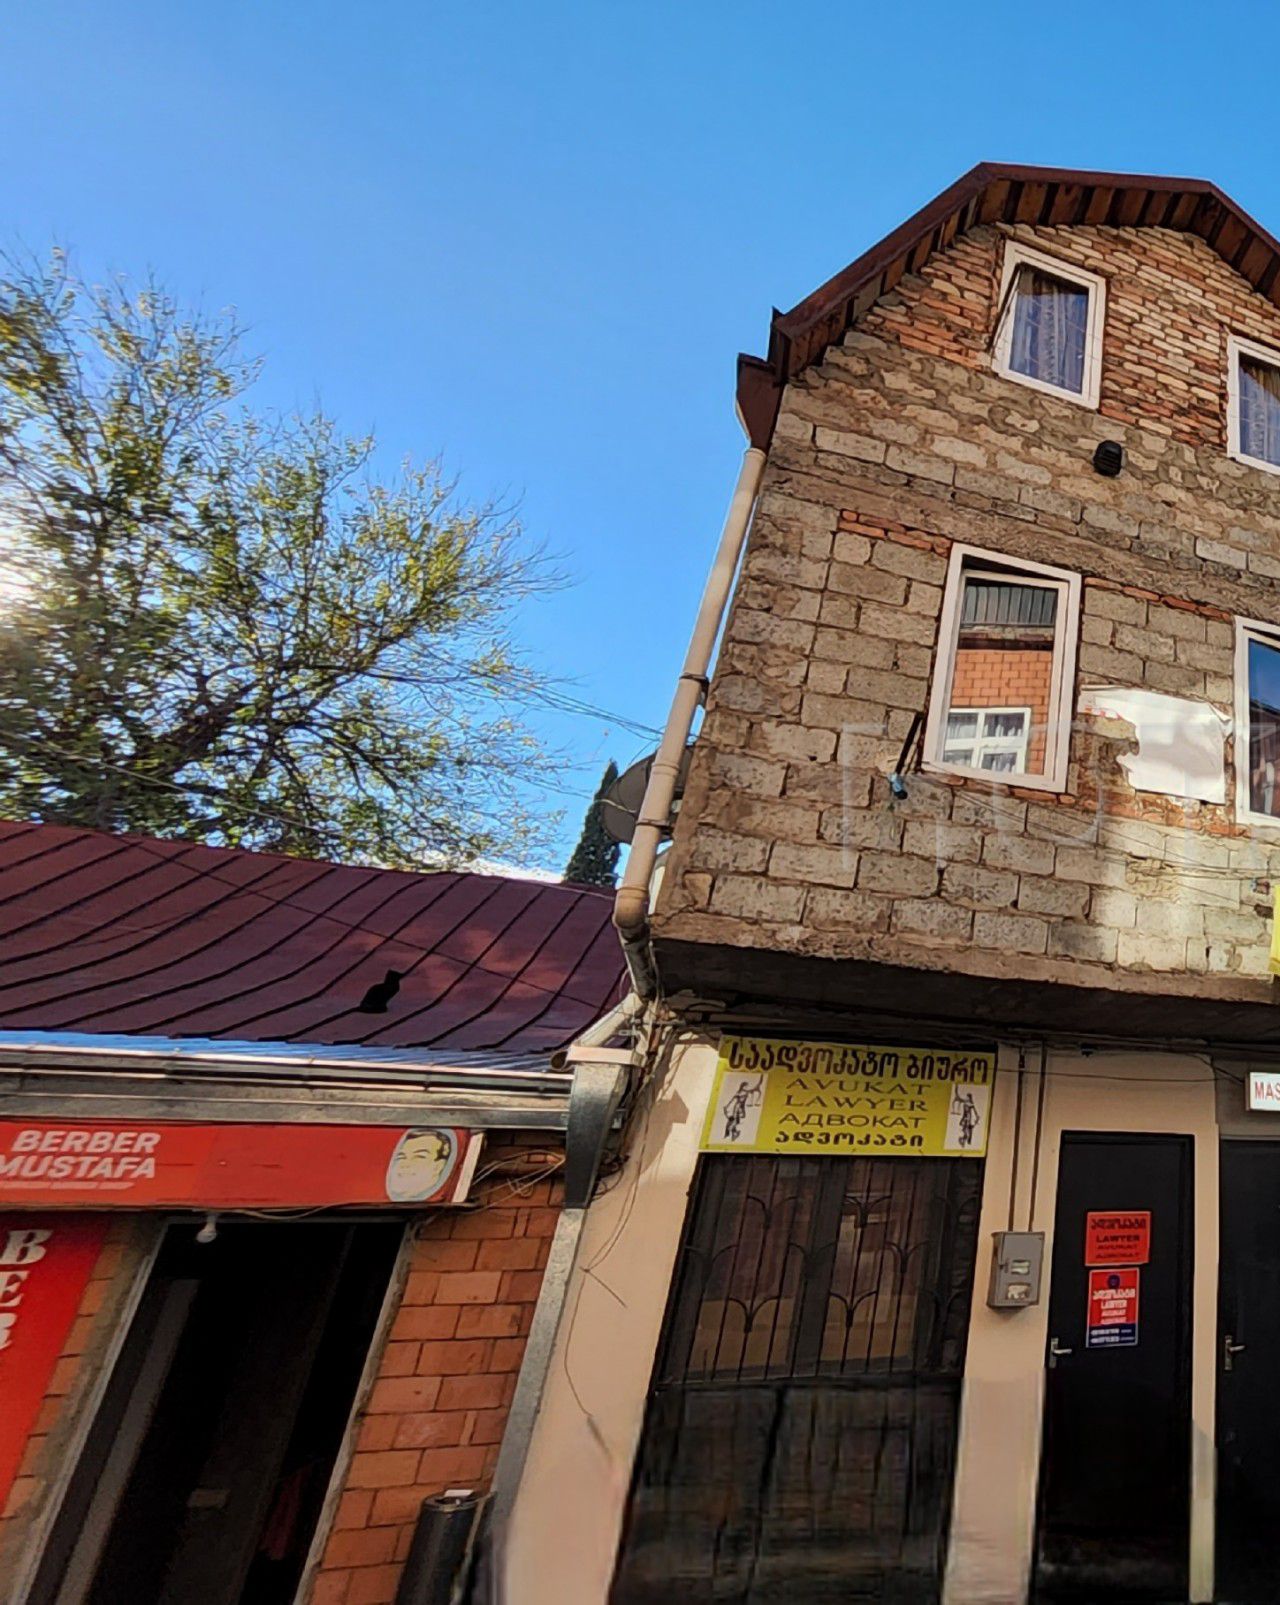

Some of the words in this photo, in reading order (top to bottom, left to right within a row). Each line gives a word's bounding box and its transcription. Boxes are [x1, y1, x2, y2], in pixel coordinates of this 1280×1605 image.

[729, 1042, 899, 1078] საადვოკატო
[906, 1054, 989, 1084] ბიურო
[785, 1078, 931, 1096] AVUKAT
[785, 1095, 928, 1112] LAWYER
[778, 1113, 927, 1129] АДВОКАТ
[11, 1130, 161, 1153] BERBER
[775, 1131, 924, 1147] ადვოკატი
[0, 1154, 155, 1179] MUSTAFA
[1096, 1235, 1140, 1243] LAWYER
